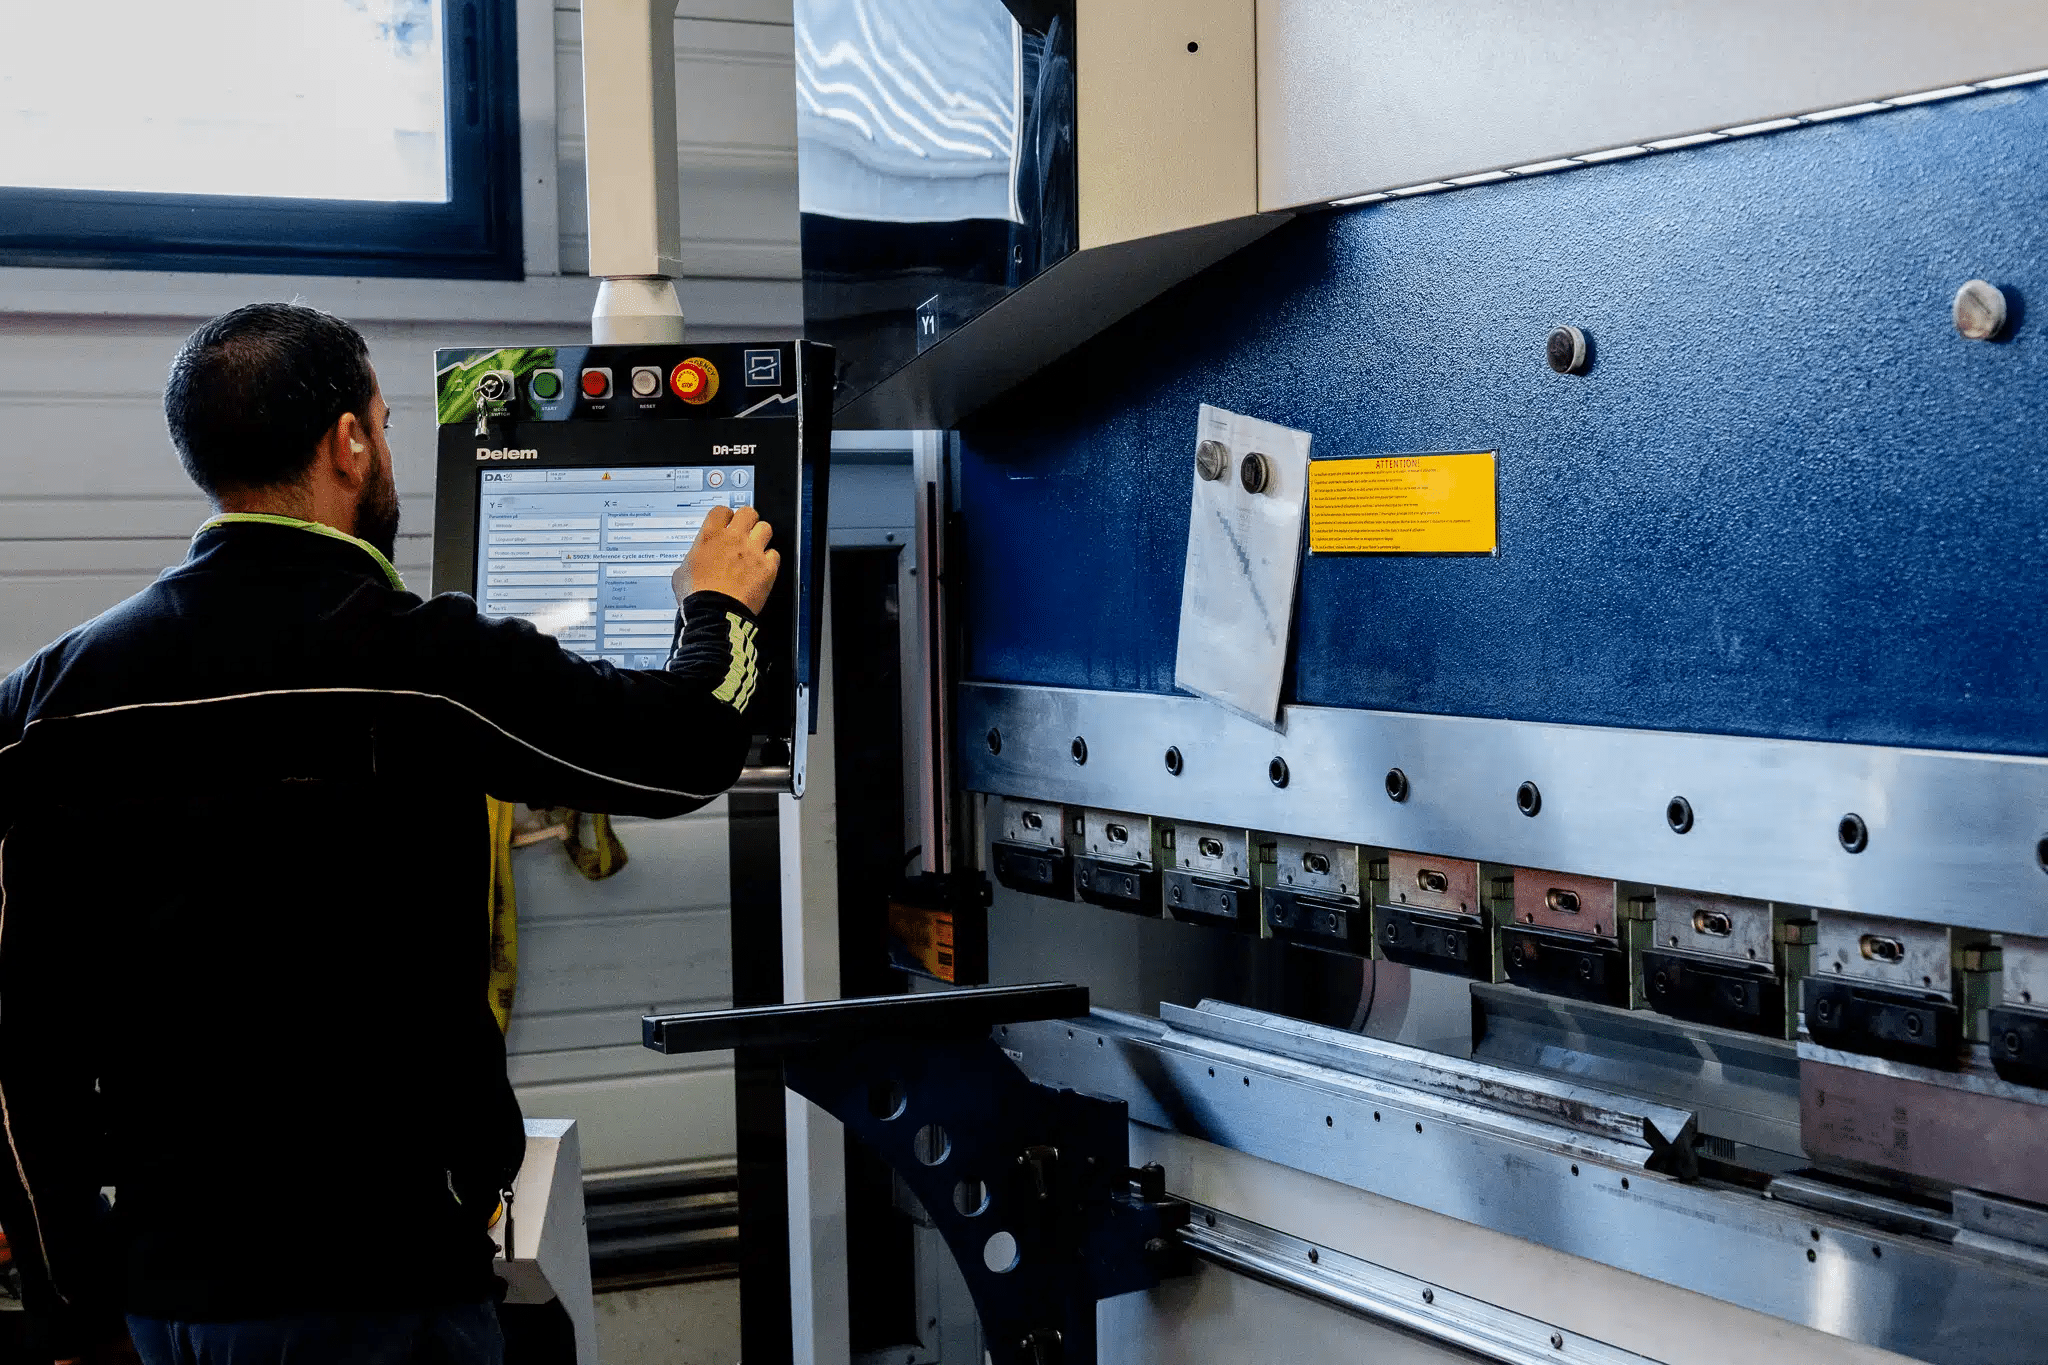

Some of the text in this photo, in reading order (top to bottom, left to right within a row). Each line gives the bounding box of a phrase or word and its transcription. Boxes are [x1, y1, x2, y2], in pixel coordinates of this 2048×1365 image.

[921, 315, 935, 335] Y1
[476, 447, 538, 461] Delem
[712, 444, 757, 456] DA-58T
[1375, 459, 1420, 470] ATTENTION!
